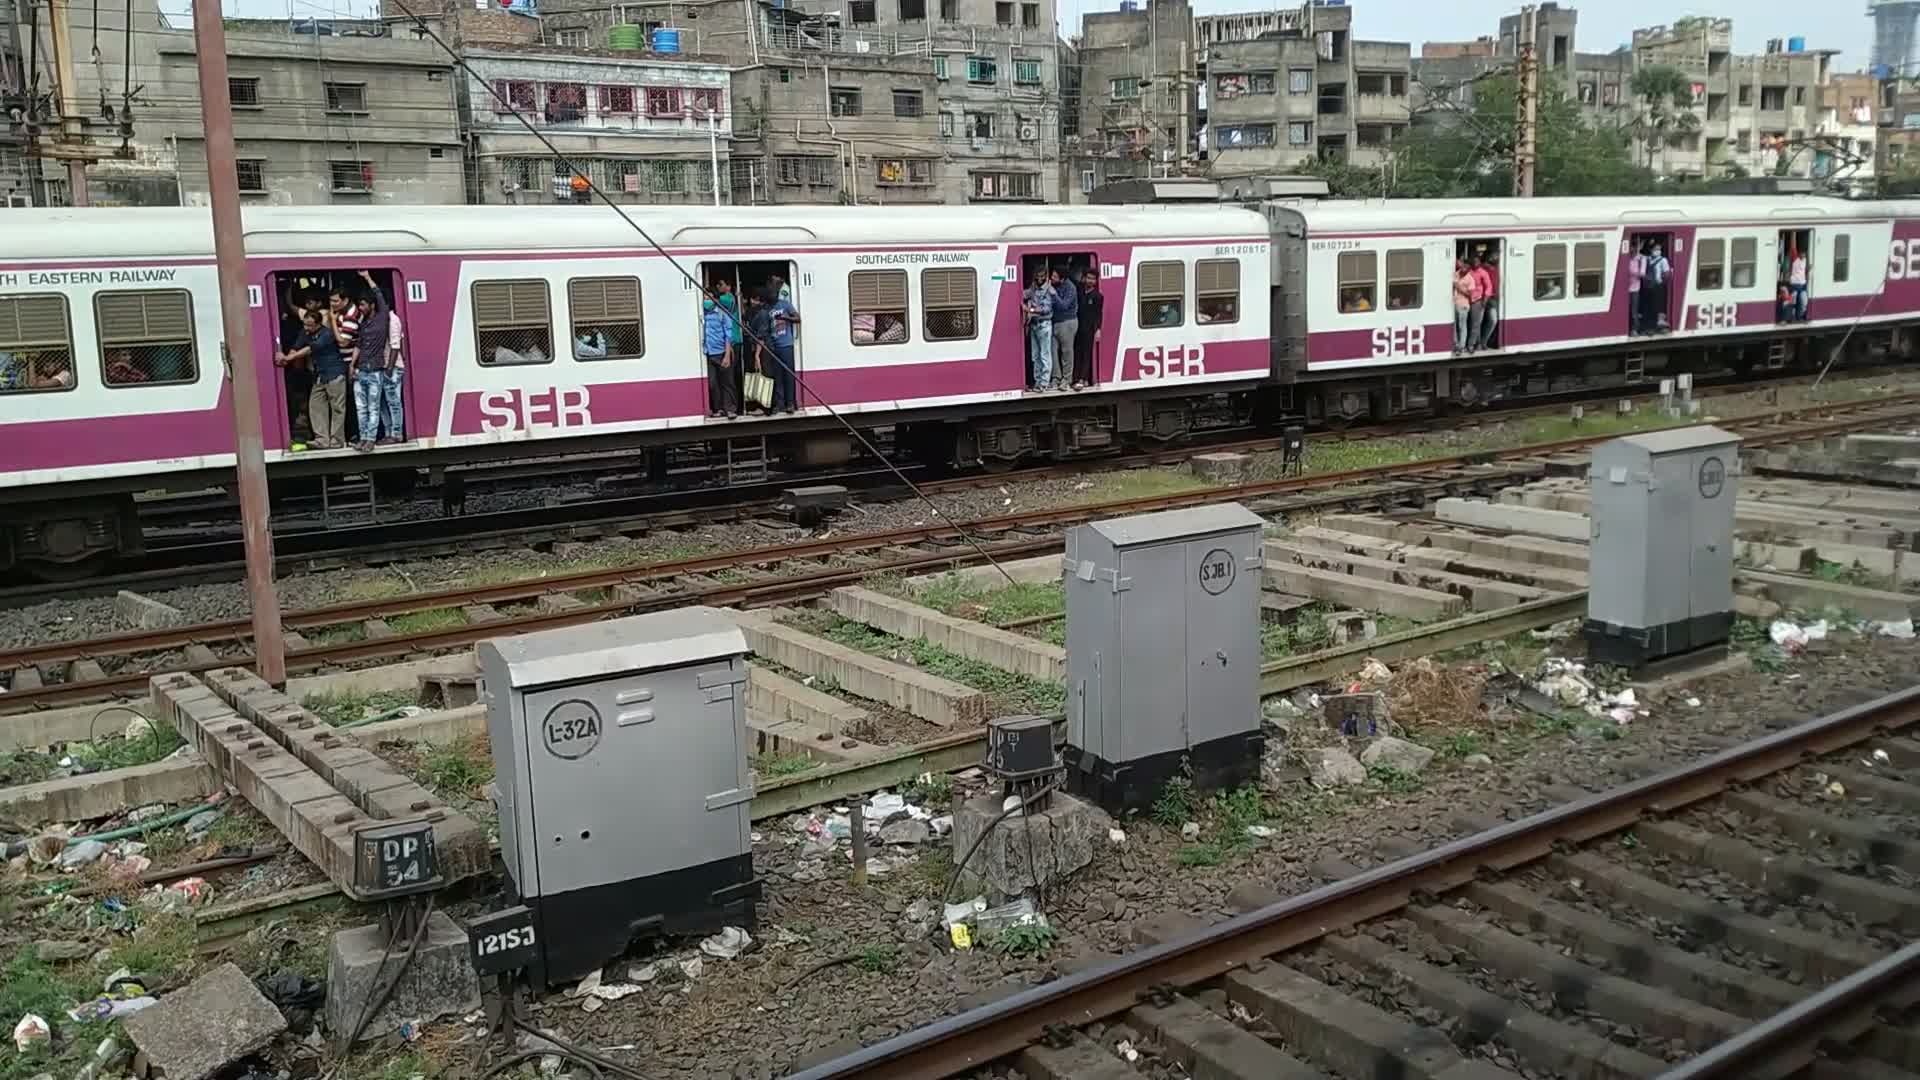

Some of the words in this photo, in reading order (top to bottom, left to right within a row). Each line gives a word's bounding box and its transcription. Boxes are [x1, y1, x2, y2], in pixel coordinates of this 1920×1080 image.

[855, 254, 929, 265] SOUTHEASTERN
[932, 252, 970, 263] RAILWAY
[29, 271, 102, 285] EASTERN
[110, 269, 177, 283] RAILWAY
[1698, 303, 1737, 330] SER
[1371, 324, 1425, 357] SER
[1138, 344, 1206, 379] SER
[479, 384, 592, 434] SER
[548, 722, 599, 744] L-32A
[383, 836, 419, 862] DP
